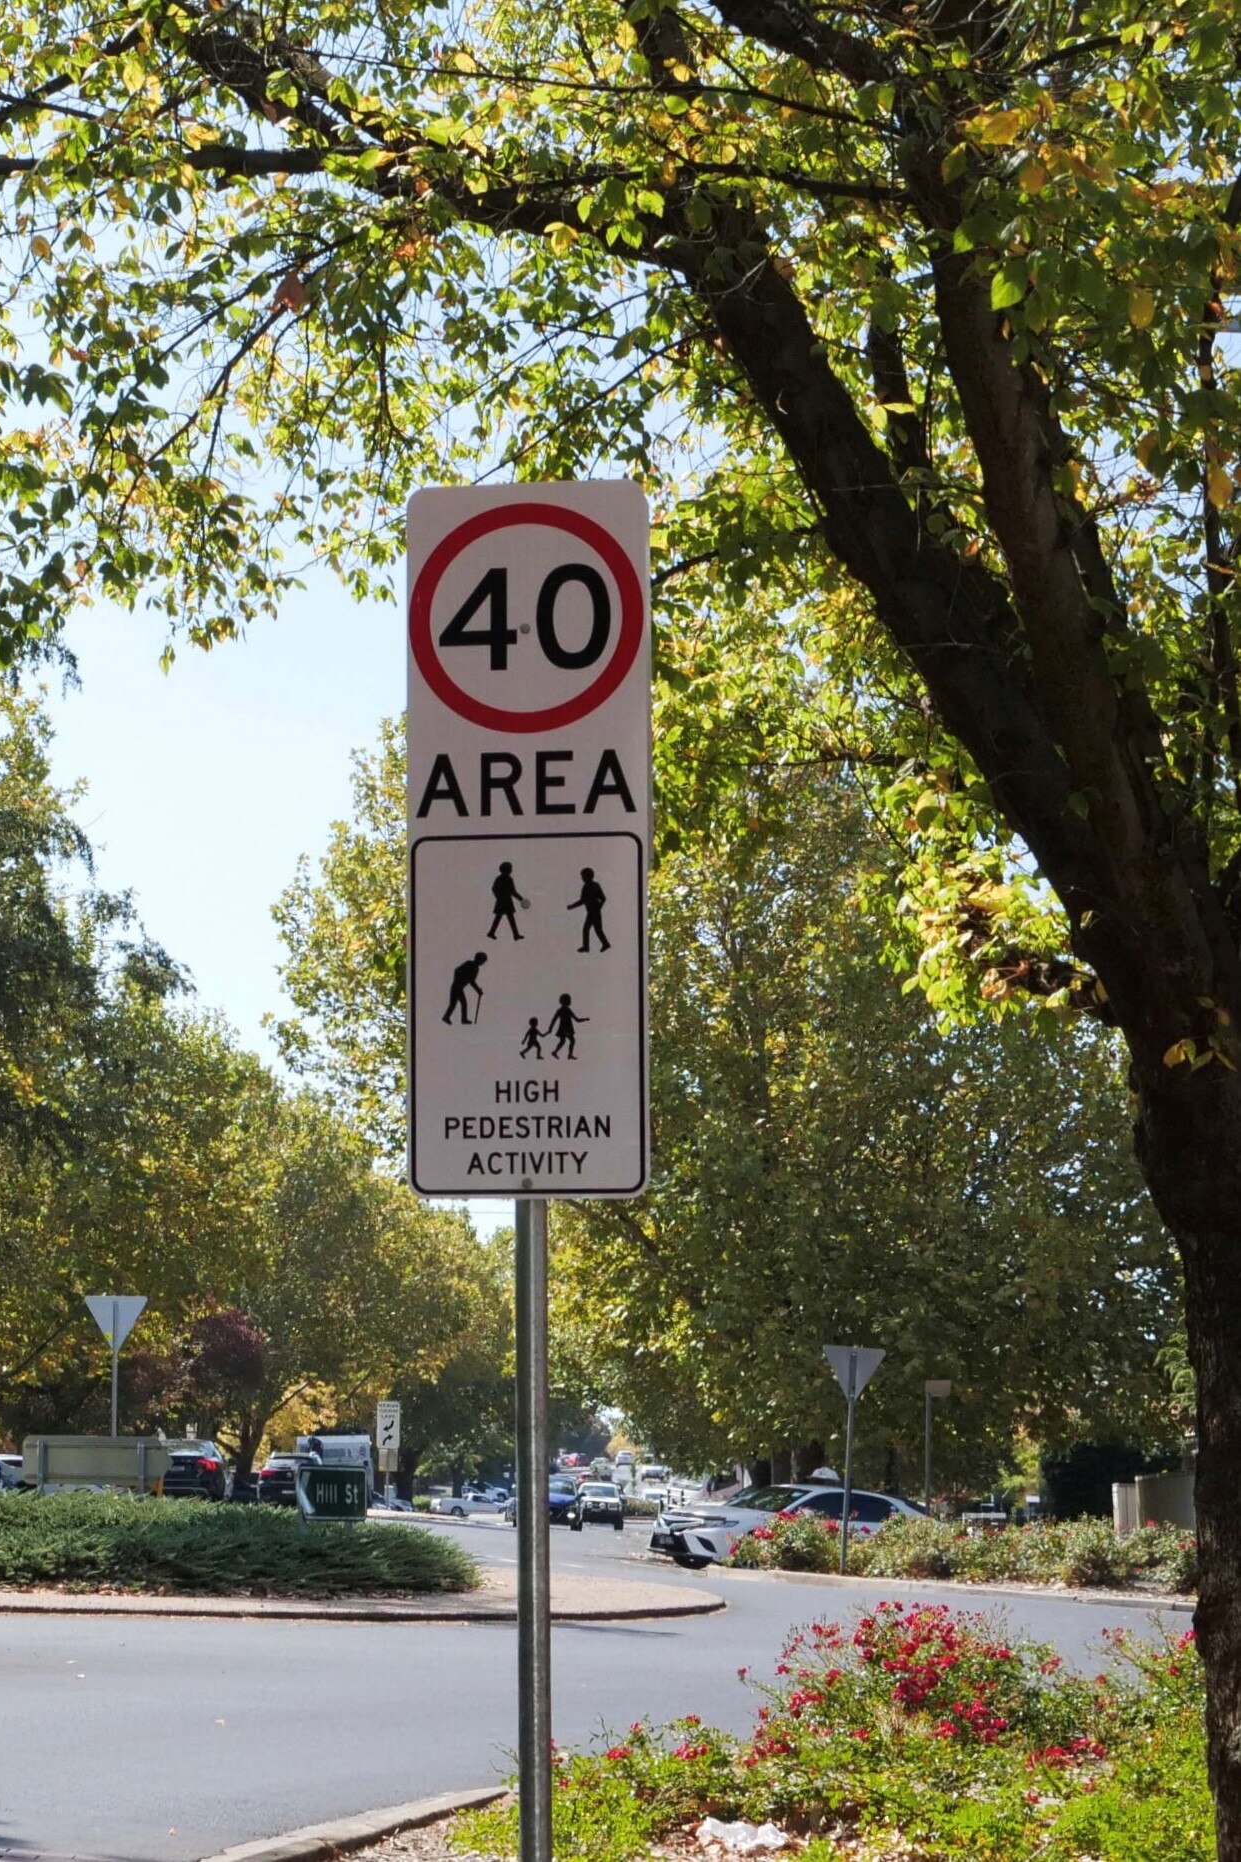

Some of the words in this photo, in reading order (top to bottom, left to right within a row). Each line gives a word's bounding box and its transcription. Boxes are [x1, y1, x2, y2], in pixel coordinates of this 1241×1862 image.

[439, 563, 611, 671] 40
[416, 749, 636, 818] AREA
[495, 1080, 559, 1103] HIGH
[445, 1115, 610, 1139] PEDESTRIAN
[467, 1151, 588, 1175] ACTIVITY
[316, 1483, 338, 1504] Hill
[345, 1483, 359, 1505] St
